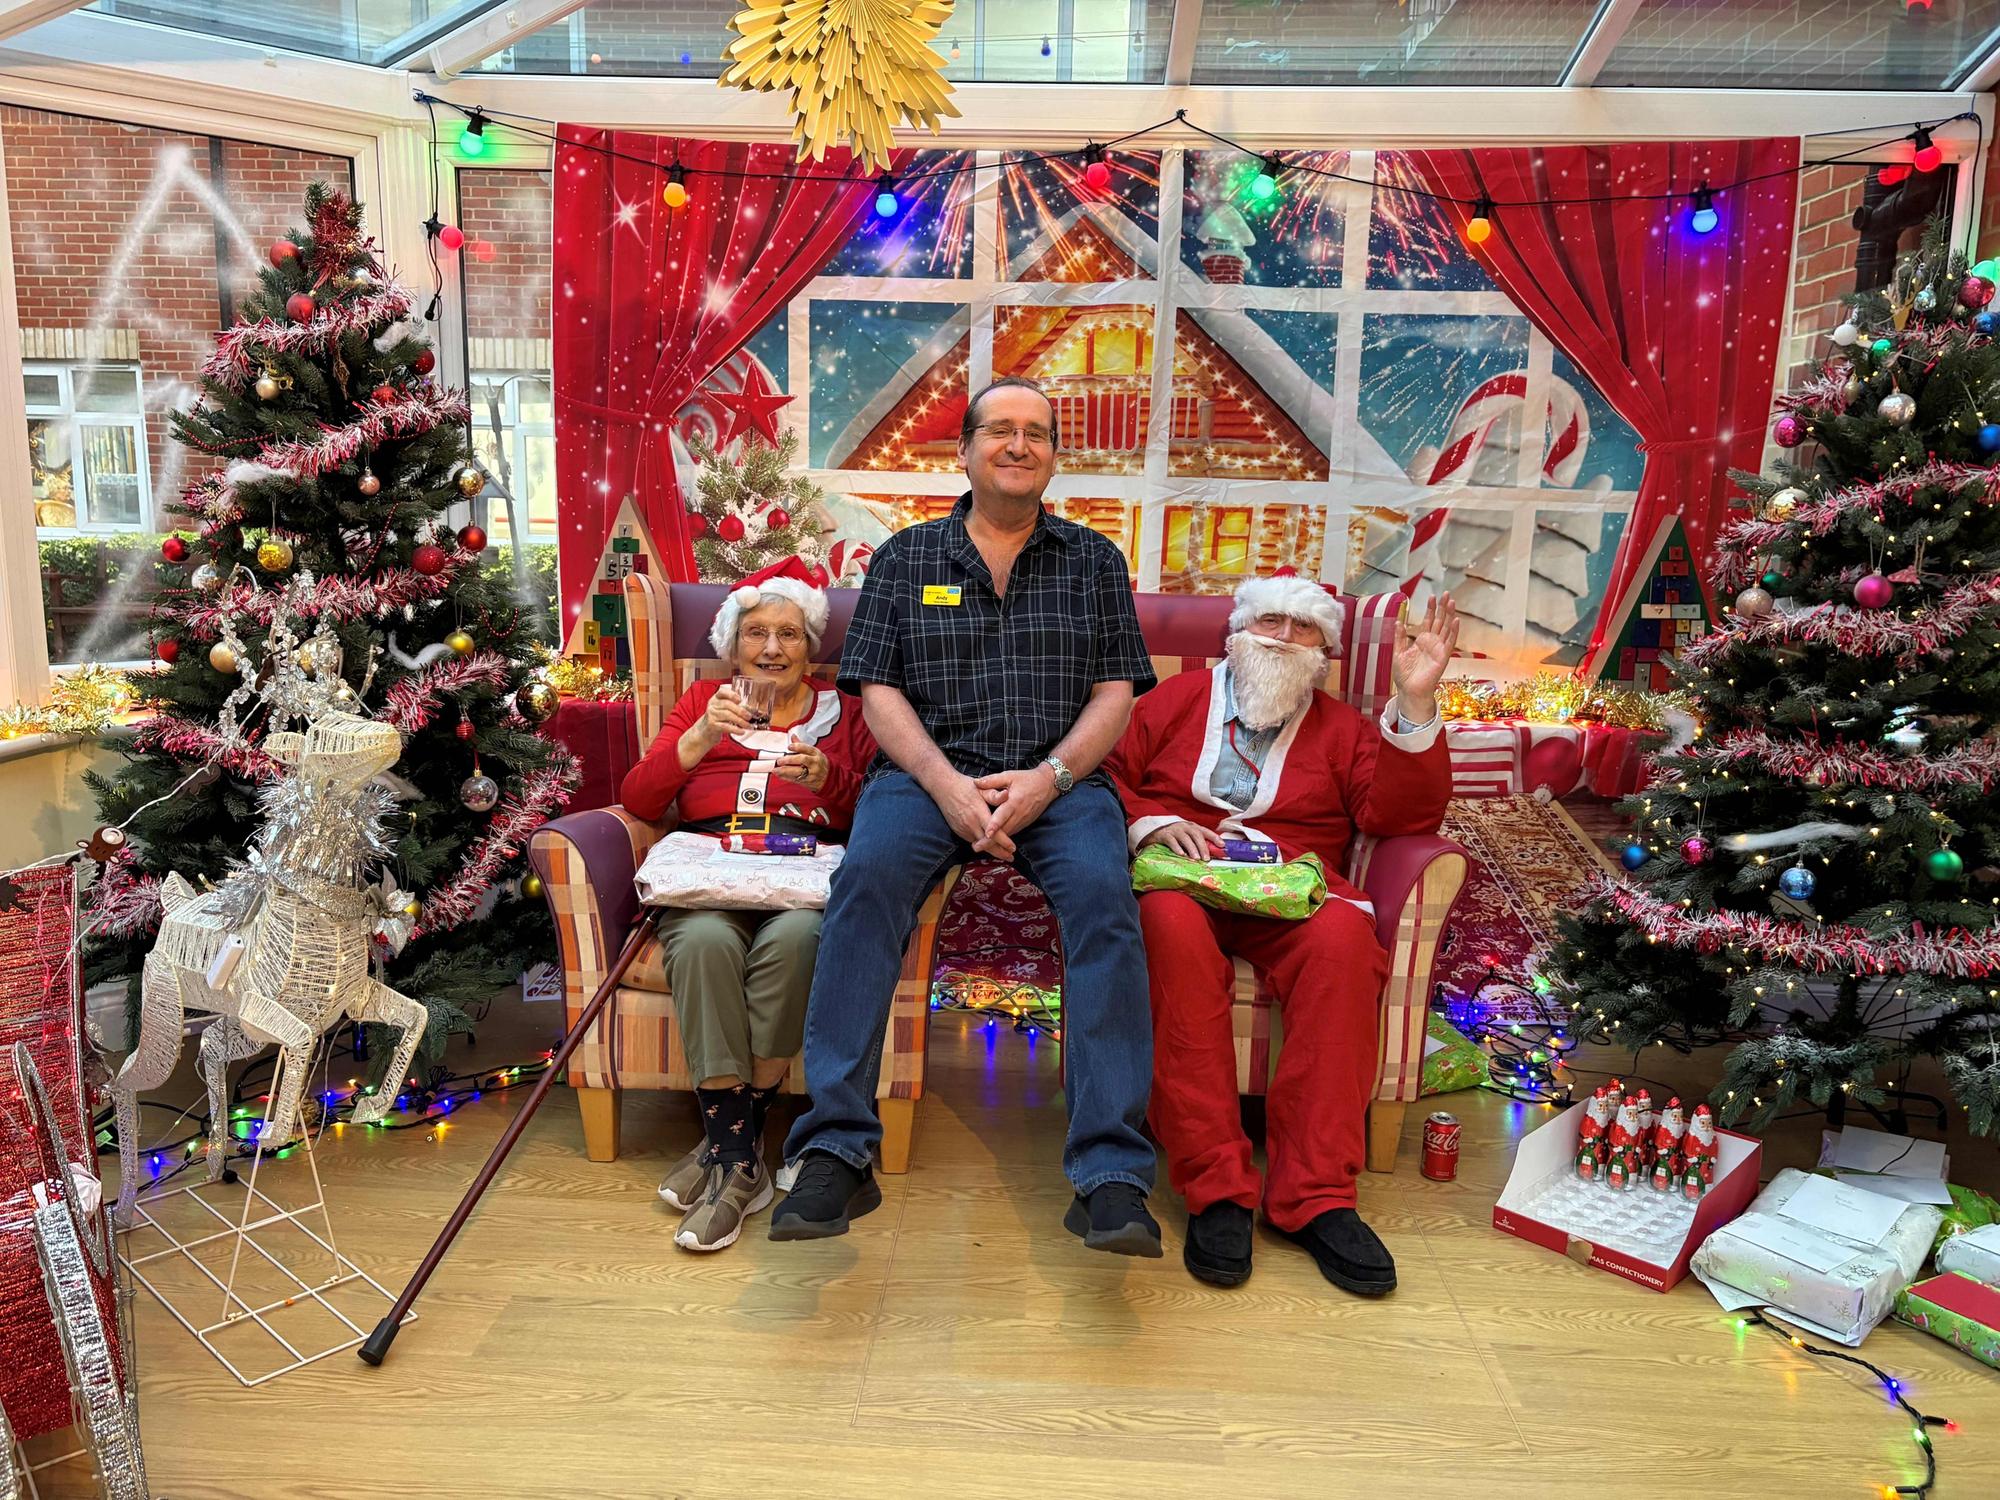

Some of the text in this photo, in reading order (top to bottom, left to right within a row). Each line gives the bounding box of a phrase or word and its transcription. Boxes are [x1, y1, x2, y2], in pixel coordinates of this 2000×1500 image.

[621, 543, 630, 552] 2
[607, 562, 618, 578] 5
[1606, 1261, 1664, 1287] CONFECTIONERY
